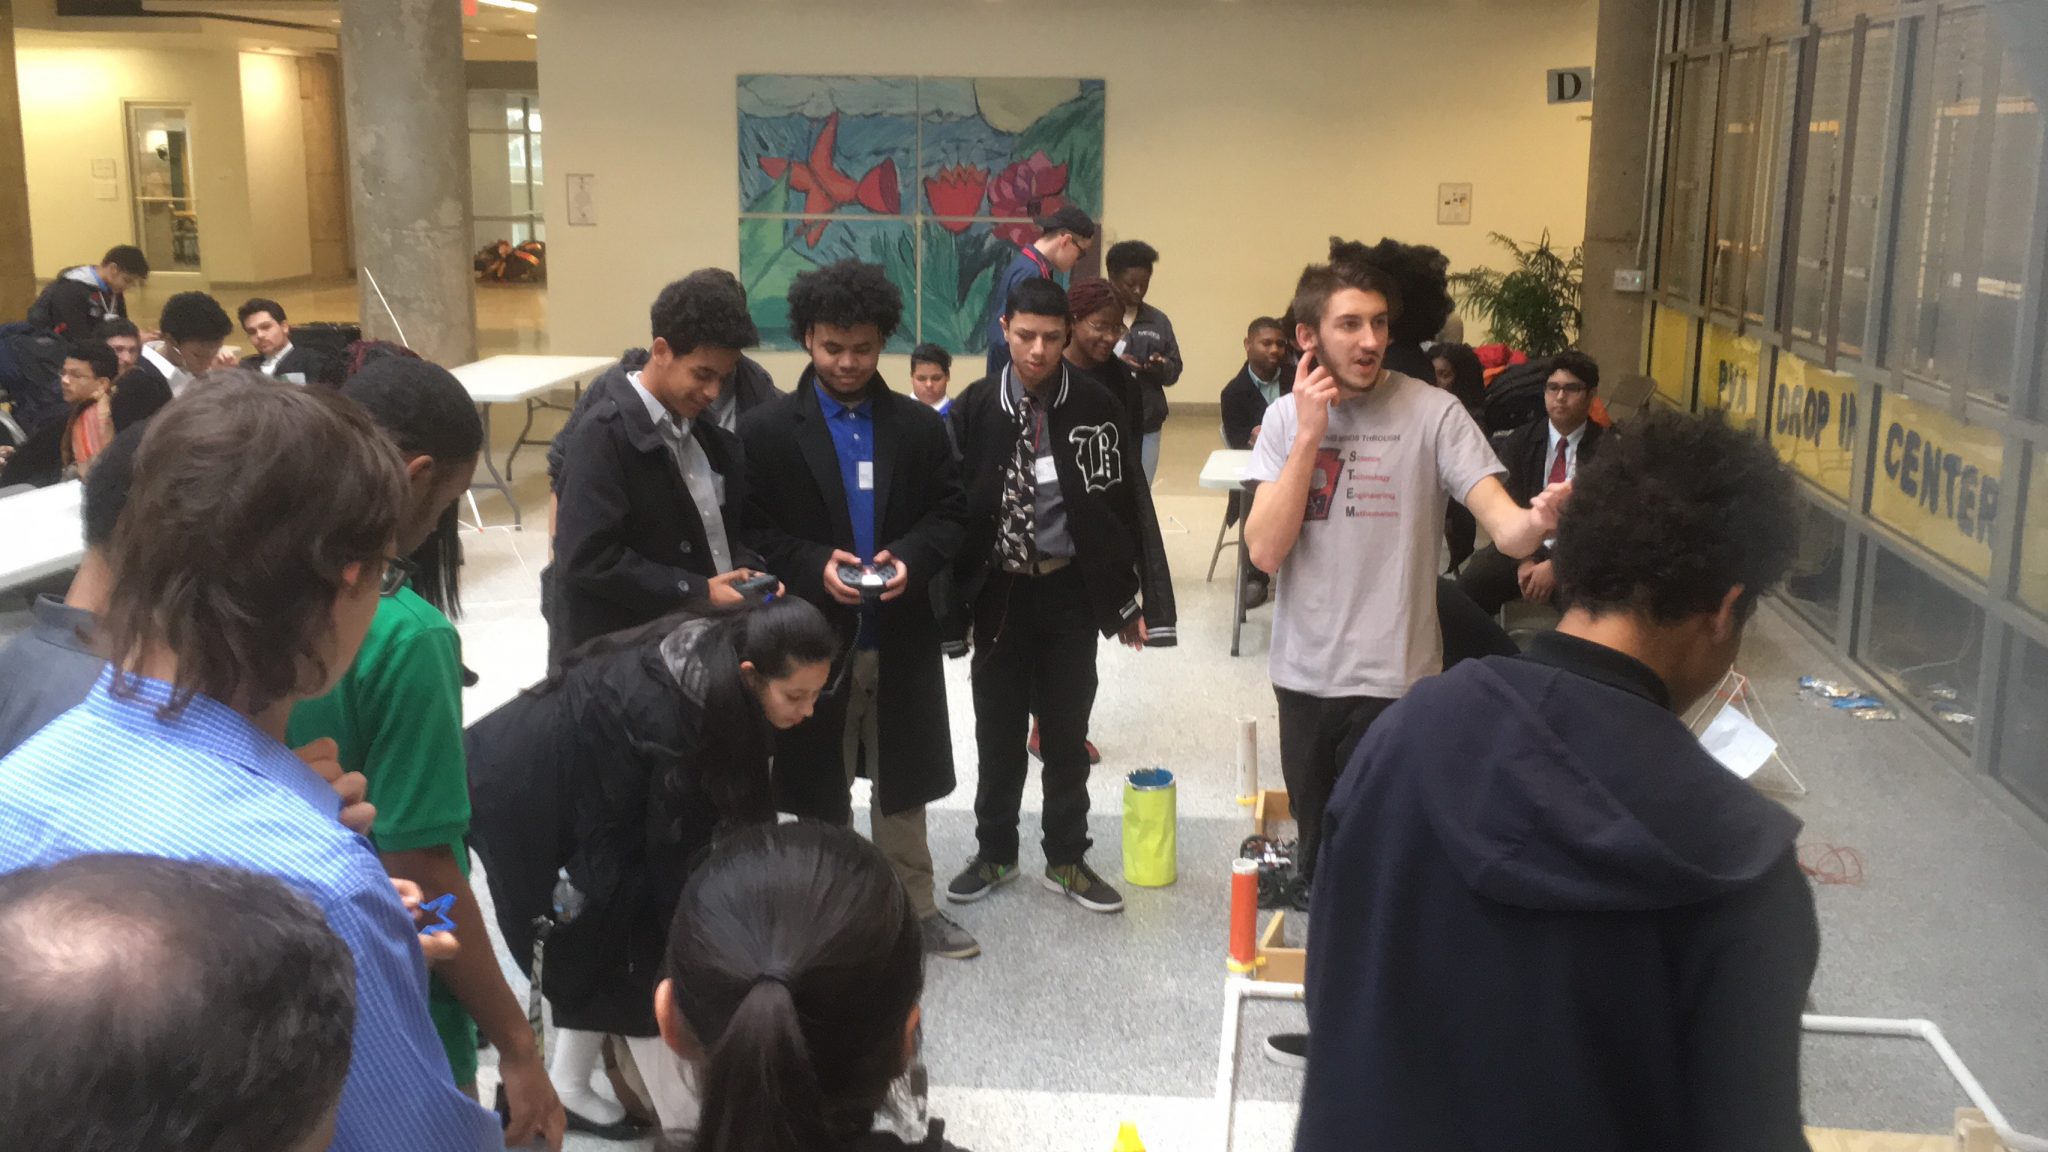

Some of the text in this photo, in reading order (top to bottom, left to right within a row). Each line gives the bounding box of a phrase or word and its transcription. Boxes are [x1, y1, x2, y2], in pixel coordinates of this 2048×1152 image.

[1557, 72, 1582, 100] D
[1362, 433, 1401, 442] THROUGH
[1777, 384, 1830, 447] DROP
[1884, 422, 2000, 551] CENTER
[1347, 468, 1391, 482] Technology
[1346, 487, 1396, 500] Engineering
